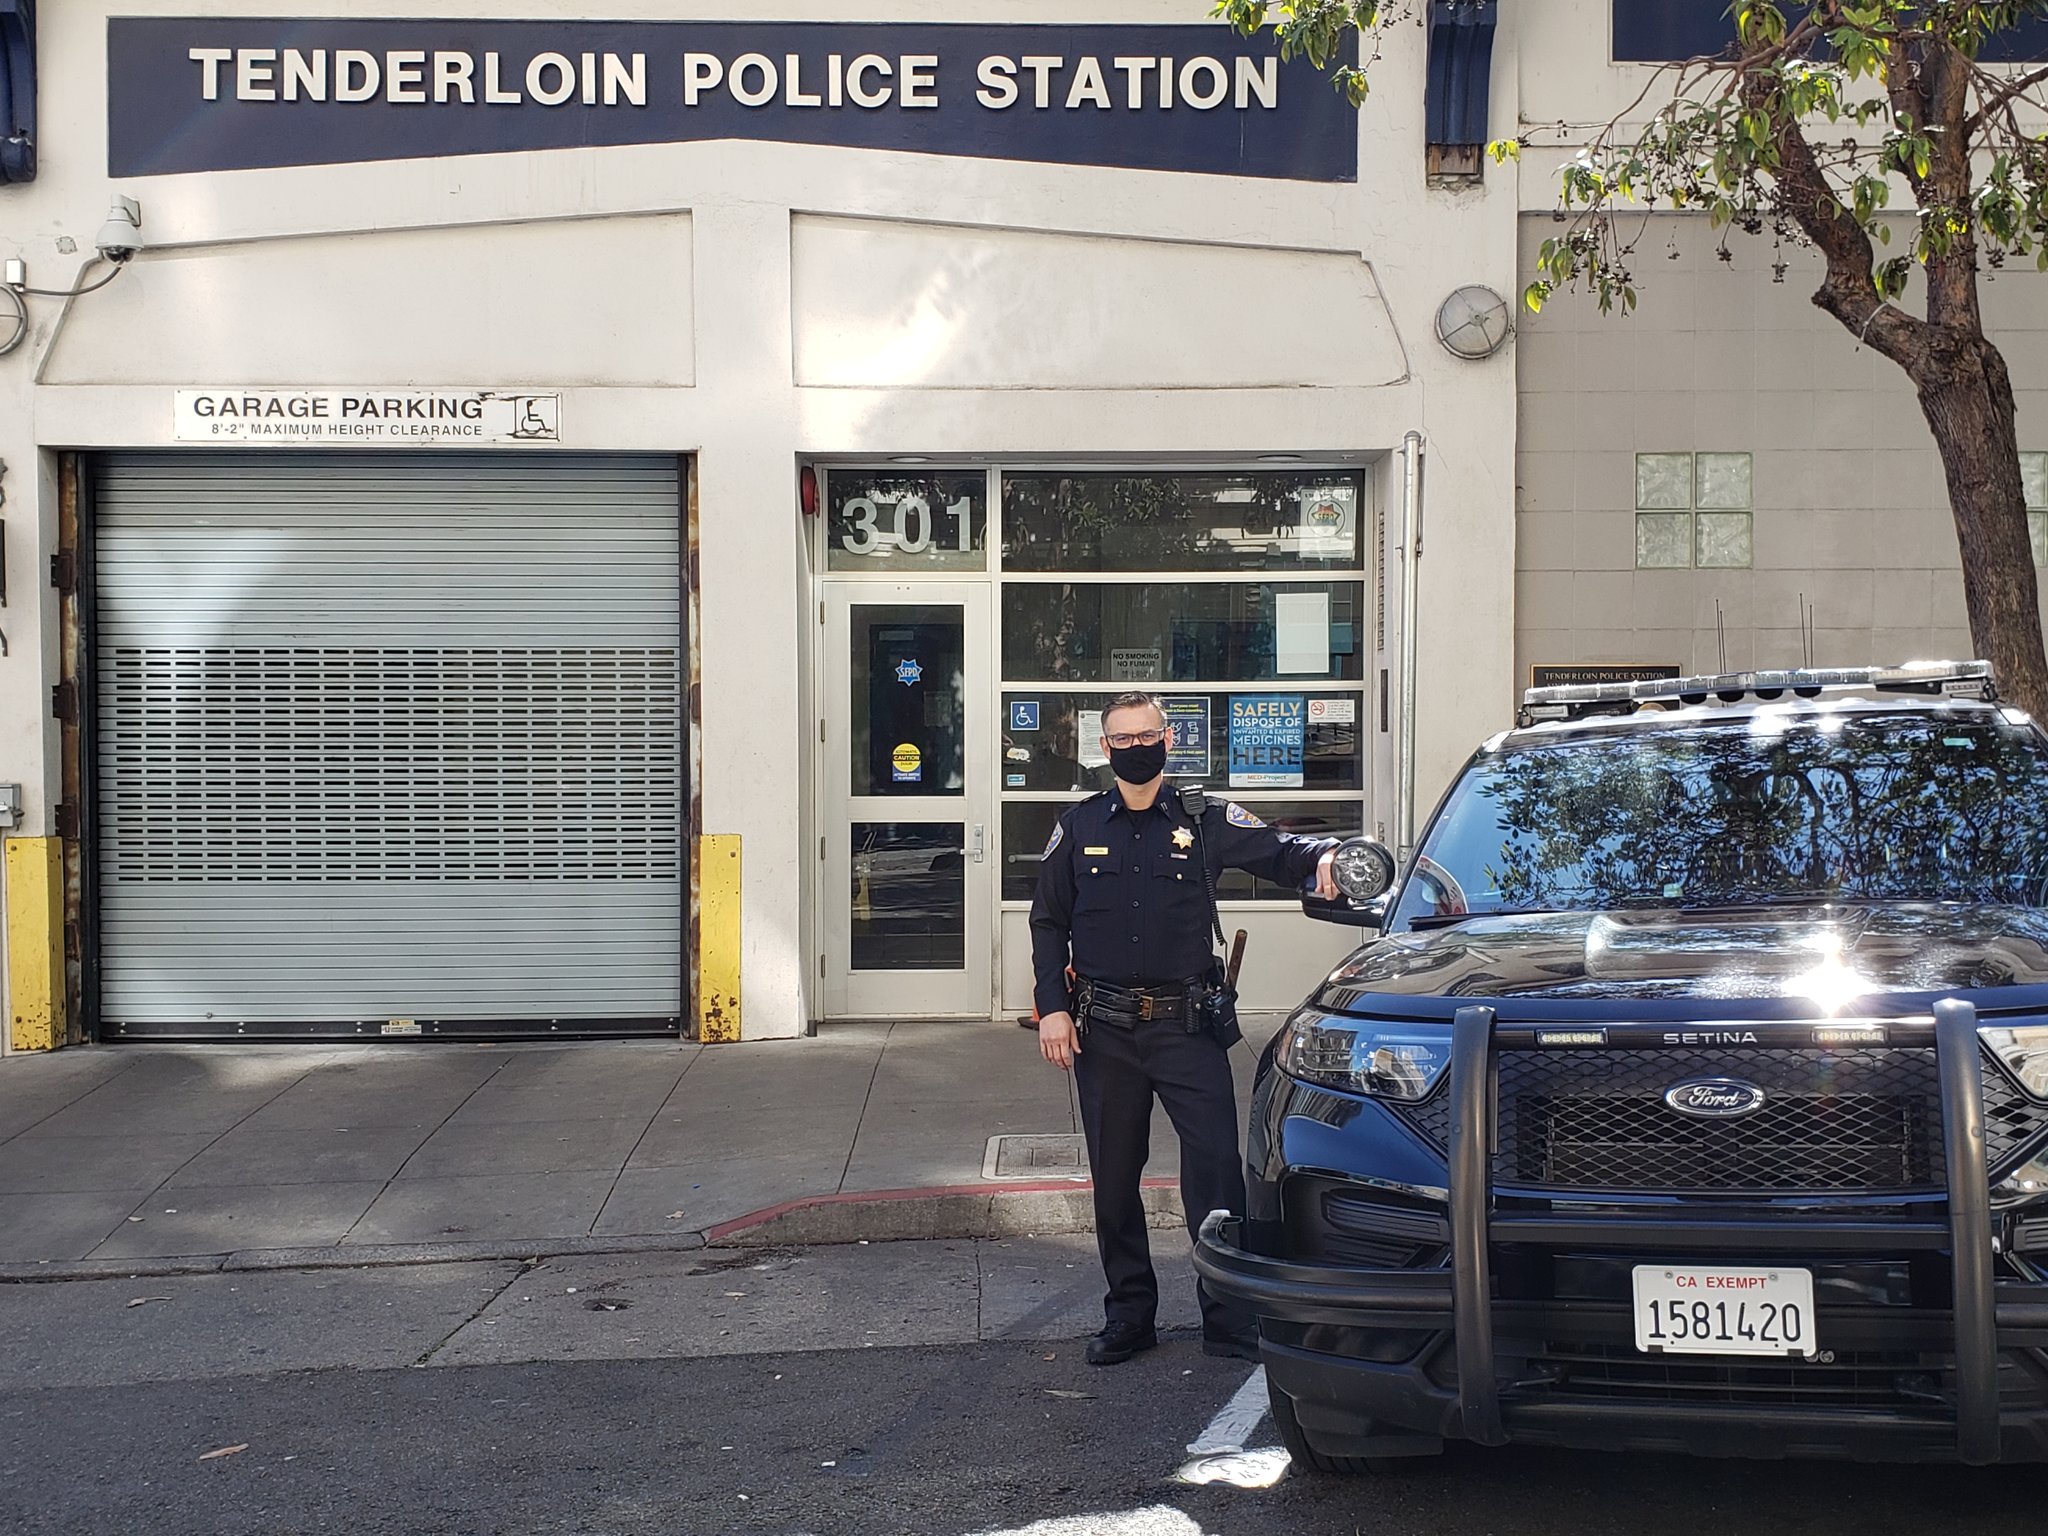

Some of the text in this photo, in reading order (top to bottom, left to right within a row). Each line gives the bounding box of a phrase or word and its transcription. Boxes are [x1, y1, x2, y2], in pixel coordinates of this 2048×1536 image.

[188, 47, 1278, 110] TENDERLOIN POLICE STATION
[193, 396, 483, 419] GARAGE PARKING
[211, 423, 483, 436] 8'-2" MAXIMUM HEIGHT CLEARANCE
[842, 496, 971, 555] 301
[900, 667, 918, 677] SFPD
[1544, 672, 1665, 680] TENDERLOIN POLICE STATION
[1232, 702, 1301, 717] SAFELY
[1233, 718, 1301, 727] DISPOSE OF
[1232, 735, 1301, 745] MEDICINES
[1232, 747, 1301, 766] HERE
[1663, 1031, 1758, 1044] SETINA
[1688, 1086, 1741, 1107] Ford
[1676, 1275, 1768, 1289] CA EXEMPT
[1648, 1299, 1801, 1342] 1581420
